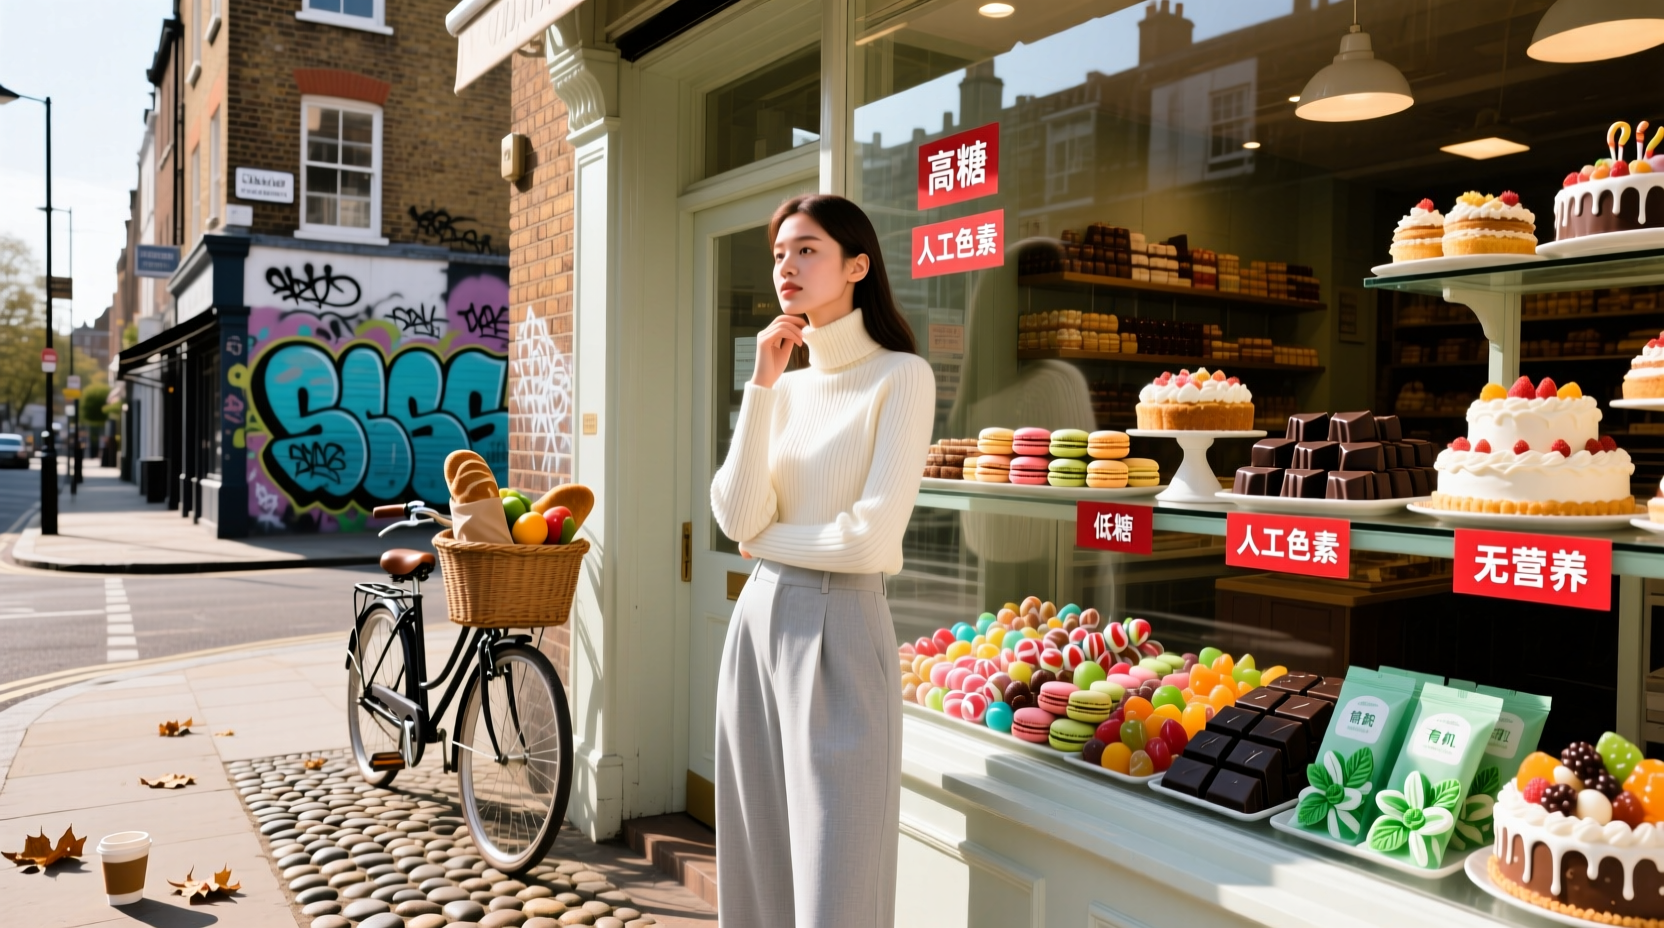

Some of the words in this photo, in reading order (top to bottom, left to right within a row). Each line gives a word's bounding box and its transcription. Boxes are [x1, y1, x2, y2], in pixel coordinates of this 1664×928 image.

[927, 139, 988, 196] 高糖
[917, 222, 998, 266] 人工色素
[1093, 511, 1134, 543] 低糖
[1236, 524, 1340, 565] 人工色素
[1473, 544, 1588, 593] 无营养
